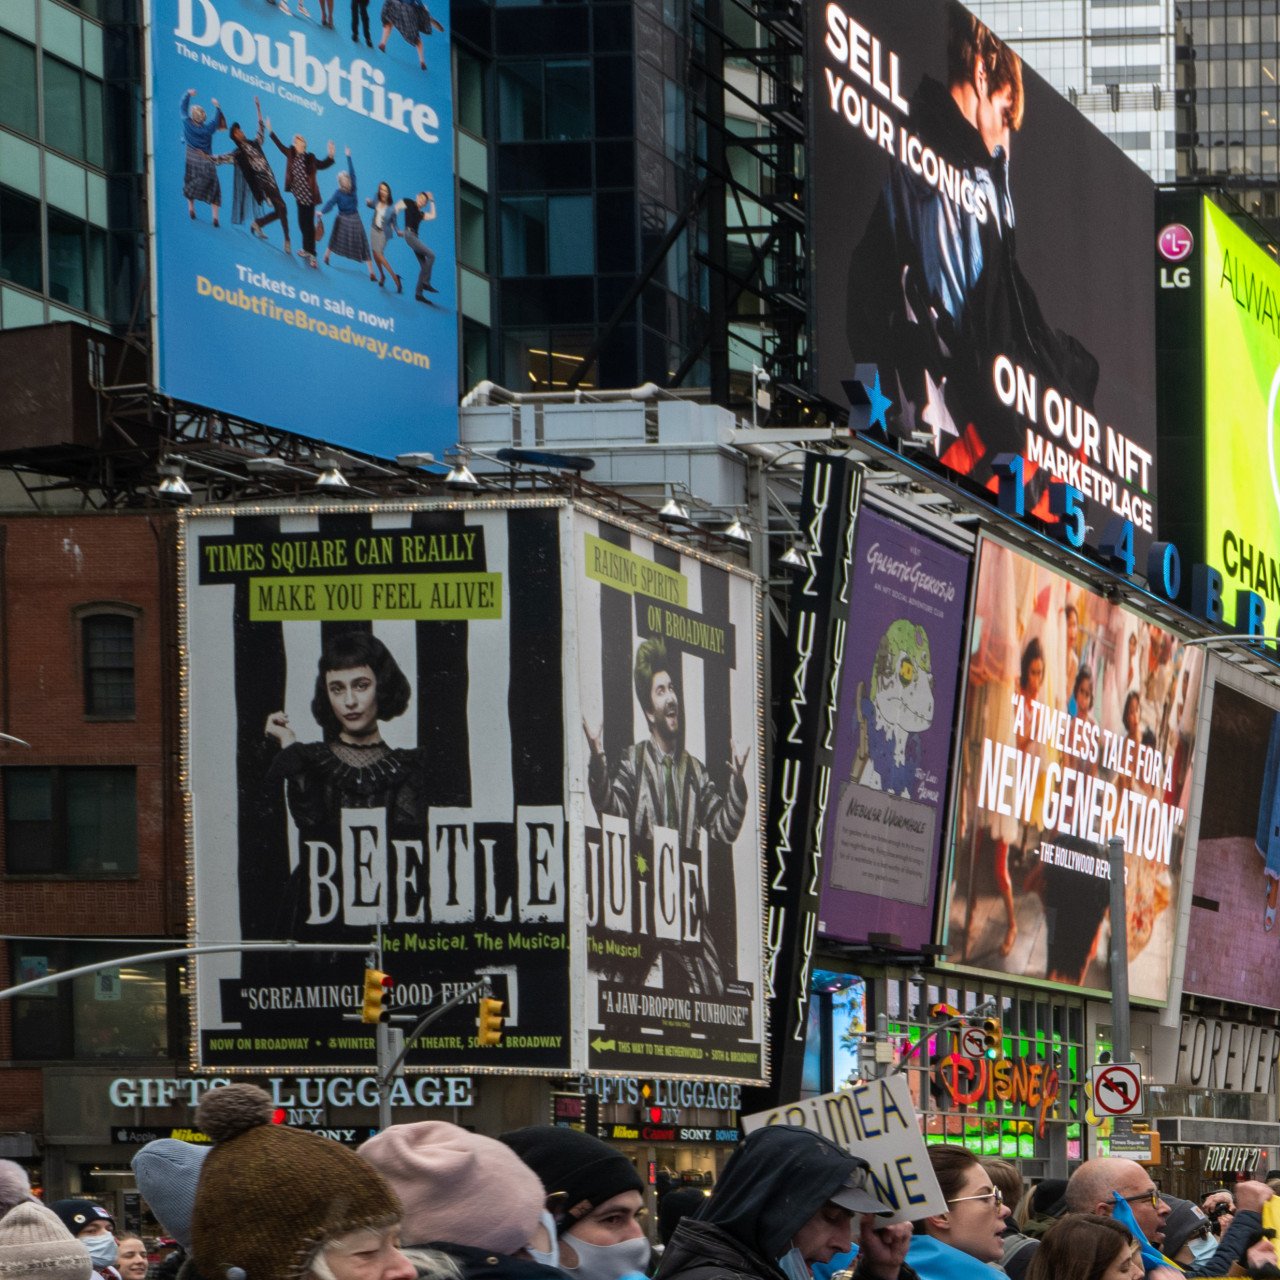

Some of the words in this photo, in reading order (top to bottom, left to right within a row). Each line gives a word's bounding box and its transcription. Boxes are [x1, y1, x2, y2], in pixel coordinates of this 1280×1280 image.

[174, 0, 440, 145] Doubtfire
[823, 2, 909, 116] SELL
[175, 42, 198, 62] The
[201, 52, 229, 74] New
[231, 65, 275, 95] Musical
[277, 85, 324, 116] Comedy
[823, 67, 895, 151] YOUR
[899, 121, 989, 224] ICONICS
[1160, 267, 1191, 289] LG
[236, 264, 296, 299] Tickets
[299, 289, 320, 307] on
[323, 296, 355, 318] sale
[358, 309, 395, 332] now!
[196, 275, 430, 370] DoubtfireBroadway.com
[993, 355, 1038, 417] ON
[1045, 386, 1102, 463] OUR
[1107, 427, 1154, 494] NFT
[1025, 428, 1154, 535] MARKETPLACE
[205, 543, 265, 573] TIMES
[271, 539, 348, 574] SQUARE
[355, 537, 394, 566] CAN
[401, 533, 476, 563] REALLY
[594, 546, 638, 587] RAISING
[641, 565, 680, 604] SPIRITS
[258, 584, 316, 612] MAKE
[319, 583, 363, 611] YOU
[372, 582, 422, 610] FEEL
[430, 581, 495, 609] ALIVE!
[647, 604, 662, 633] ON
[665, 610, 725, 655] BROADWAY!
[1030, 699, 1101, 764] TIMELESS
[1102, 729, 1135, 777] TALE
[1135, 743, 1163, 789] FOR
[1163, 755, 1173, 792] A
[977, 737, 1041, 823] NEW
[305, 812, 563, 925] BEETLE
[1040, 841, 1054, 865] THE
[1054, 845, 1095, 876] HOLLYWOOD
[404, 934, 468, 951] Musical.
[474, 932, 503, 951] The
[507, 932, 571, 950] Musical.
[586, 937, 604, 954] The
[615, 993, 692, 1021] JAW-DROPPING
[209, 1039, 233, 1051] NOW
[236, 1039, 251, 1051] ON
[254, 1038, 309, 1051] BROADWAY
[338, 1037, 376, 1050] WINTER
[506, 1036, 562, 1049] BROADWAY
[618, 1041, 630, 1053] THIS
[631, 1042, 646, 1054] WAY
[269, 1077, 474, 1107] LUGGAGE
[654, 1079, 742, 1111] LUGGAGE
[128, 1130, 158, 1142] Apple
[288, 1108, 324, 1126] NY
[680, 1128, 713, 1141] SONY
[1204, 1147, 1250, 1172] FOREVER
